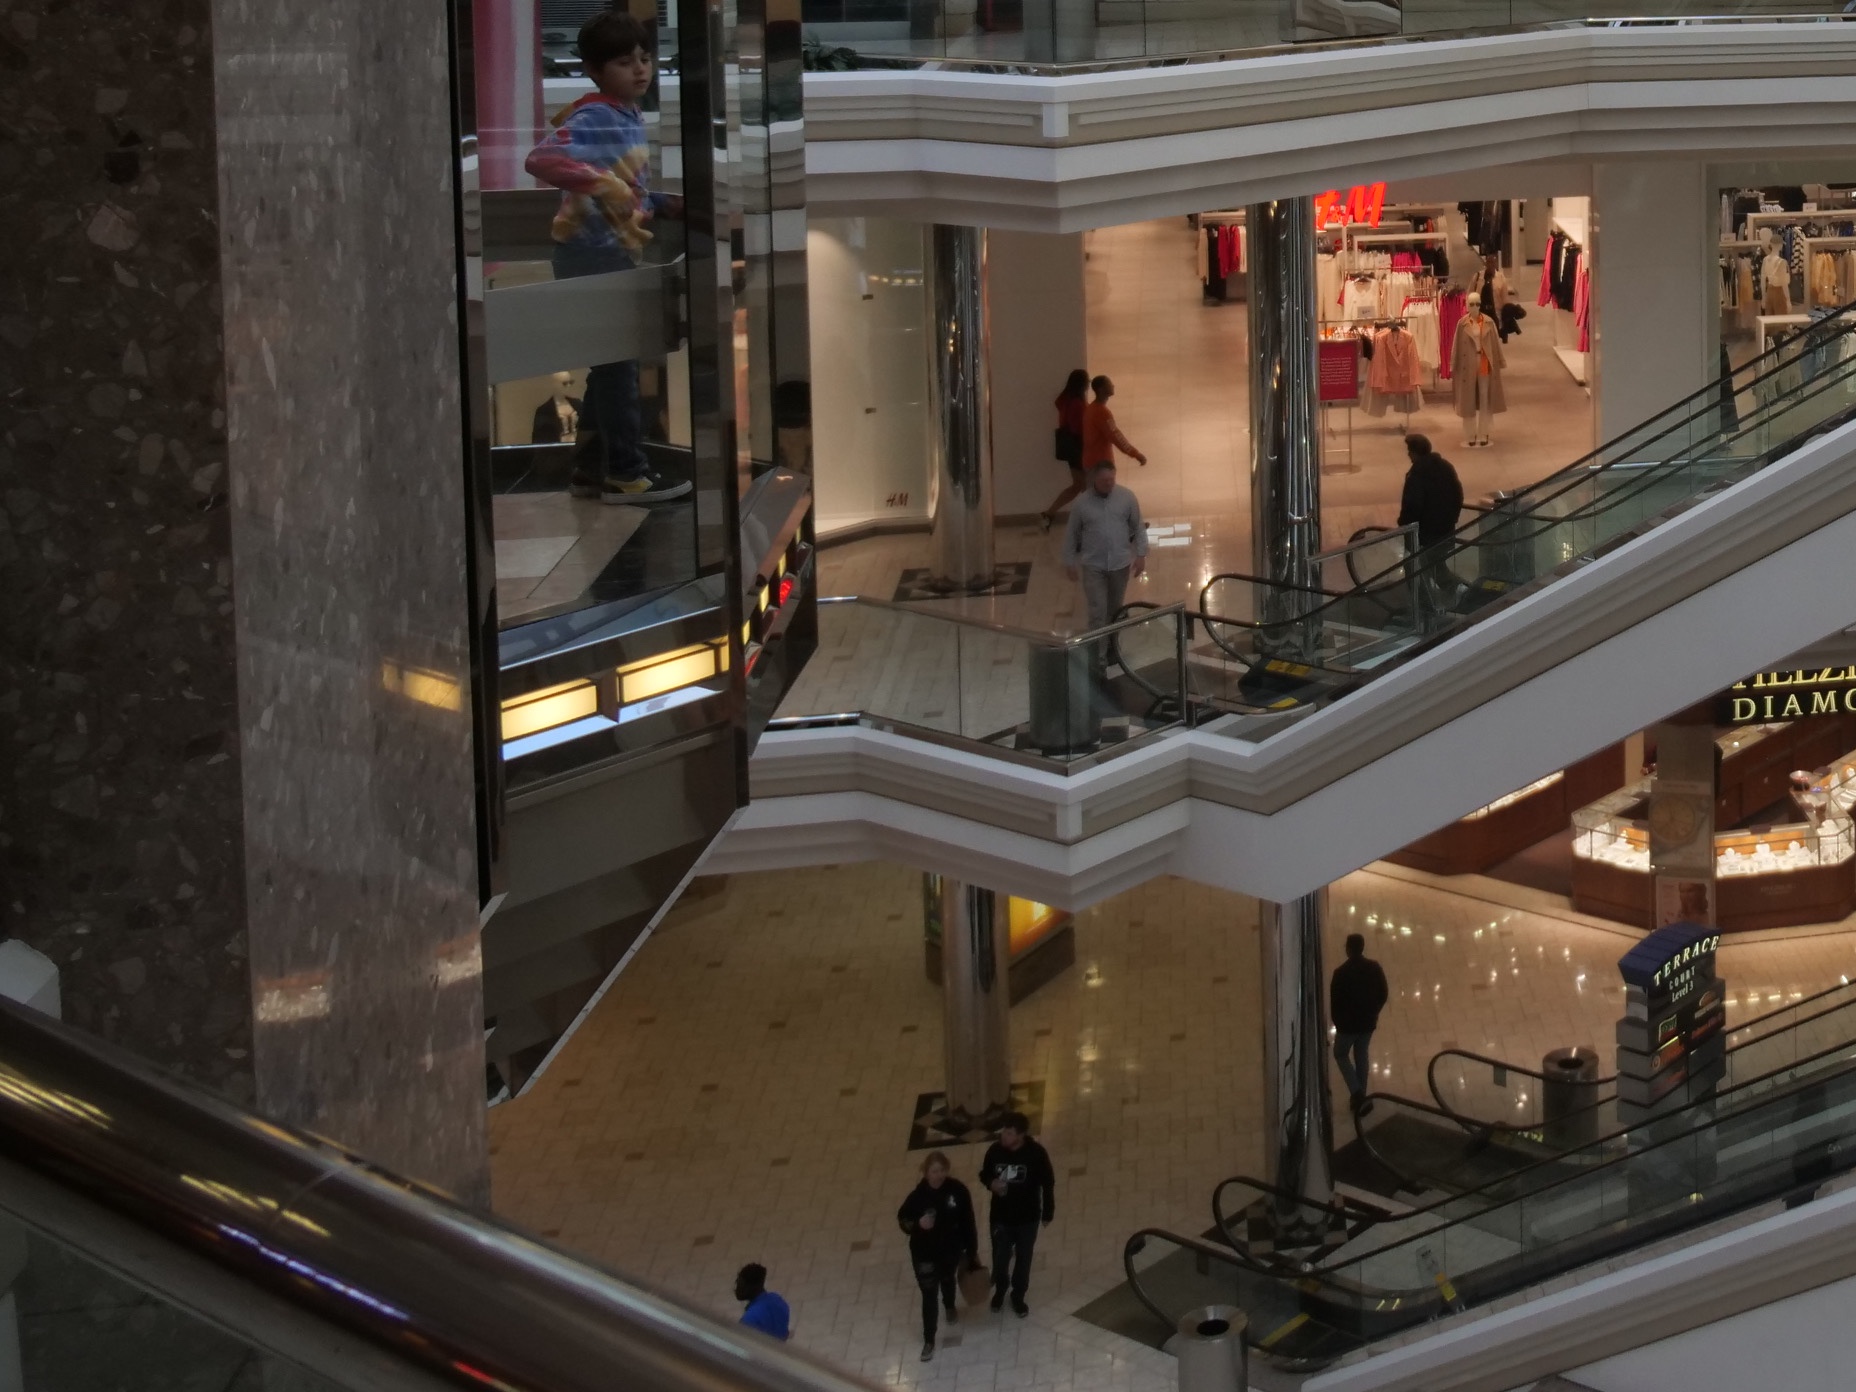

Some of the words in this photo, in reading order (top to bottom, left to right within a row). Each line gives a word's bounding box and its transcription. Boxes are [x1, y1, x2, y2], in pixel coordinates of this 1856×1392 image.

[1653, 935, 1720, 987] TERRACE
[1669, 966, 1696, 991] COURT
[1671, 985, 1689, 1003] Level
[1688, 980, 1695, 994] 3
